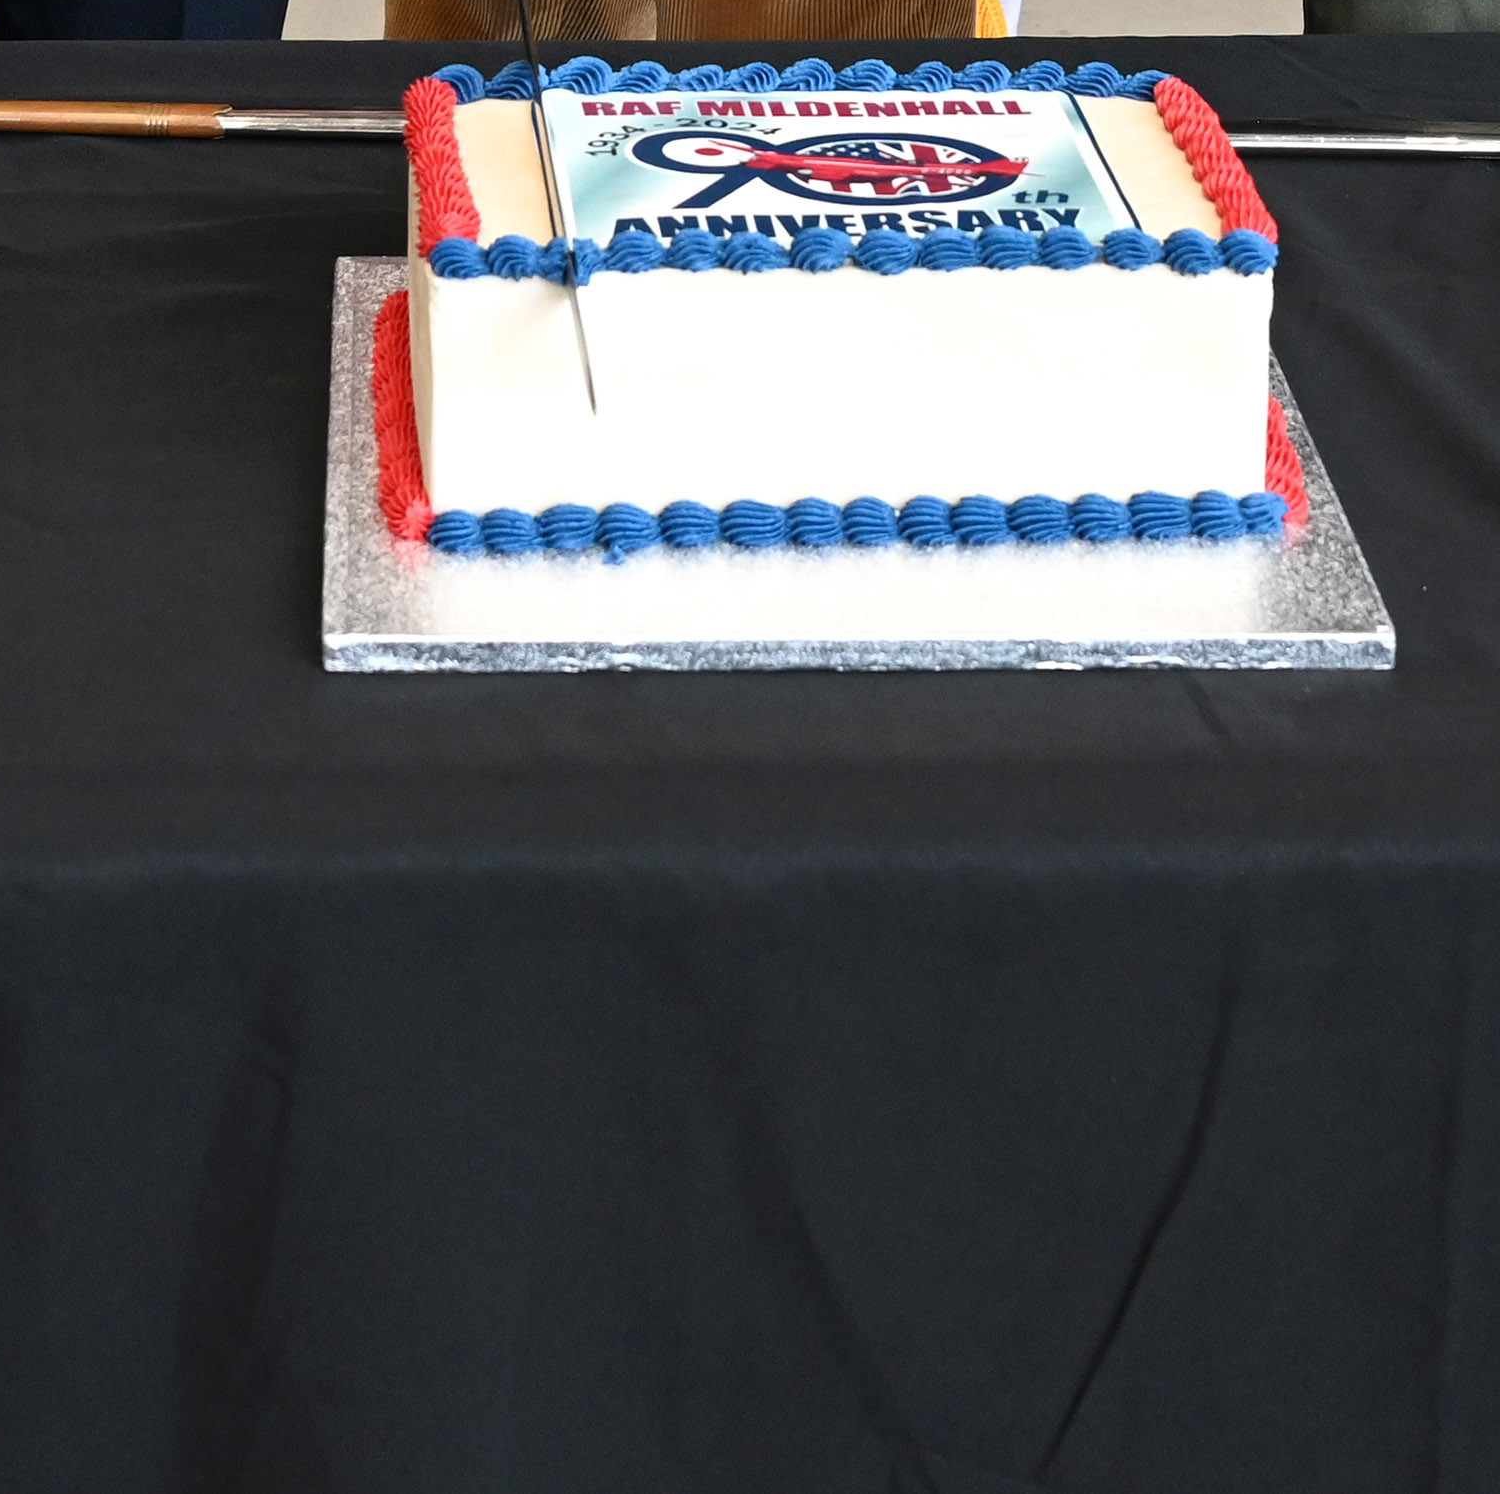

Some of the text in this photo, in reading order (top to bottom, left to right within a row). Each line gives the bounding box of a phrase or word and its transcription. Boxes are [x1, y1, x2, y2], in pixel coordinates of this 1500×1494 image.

[581, 101, 1032, 117] RAF MILDENHALL
[585, 125, 647, 157] 1934
[675, 117, 782, 134] 2024
[1012, 190, 1069, 204] th
[614, 208, 1080, 238] ANNIVERSARY
